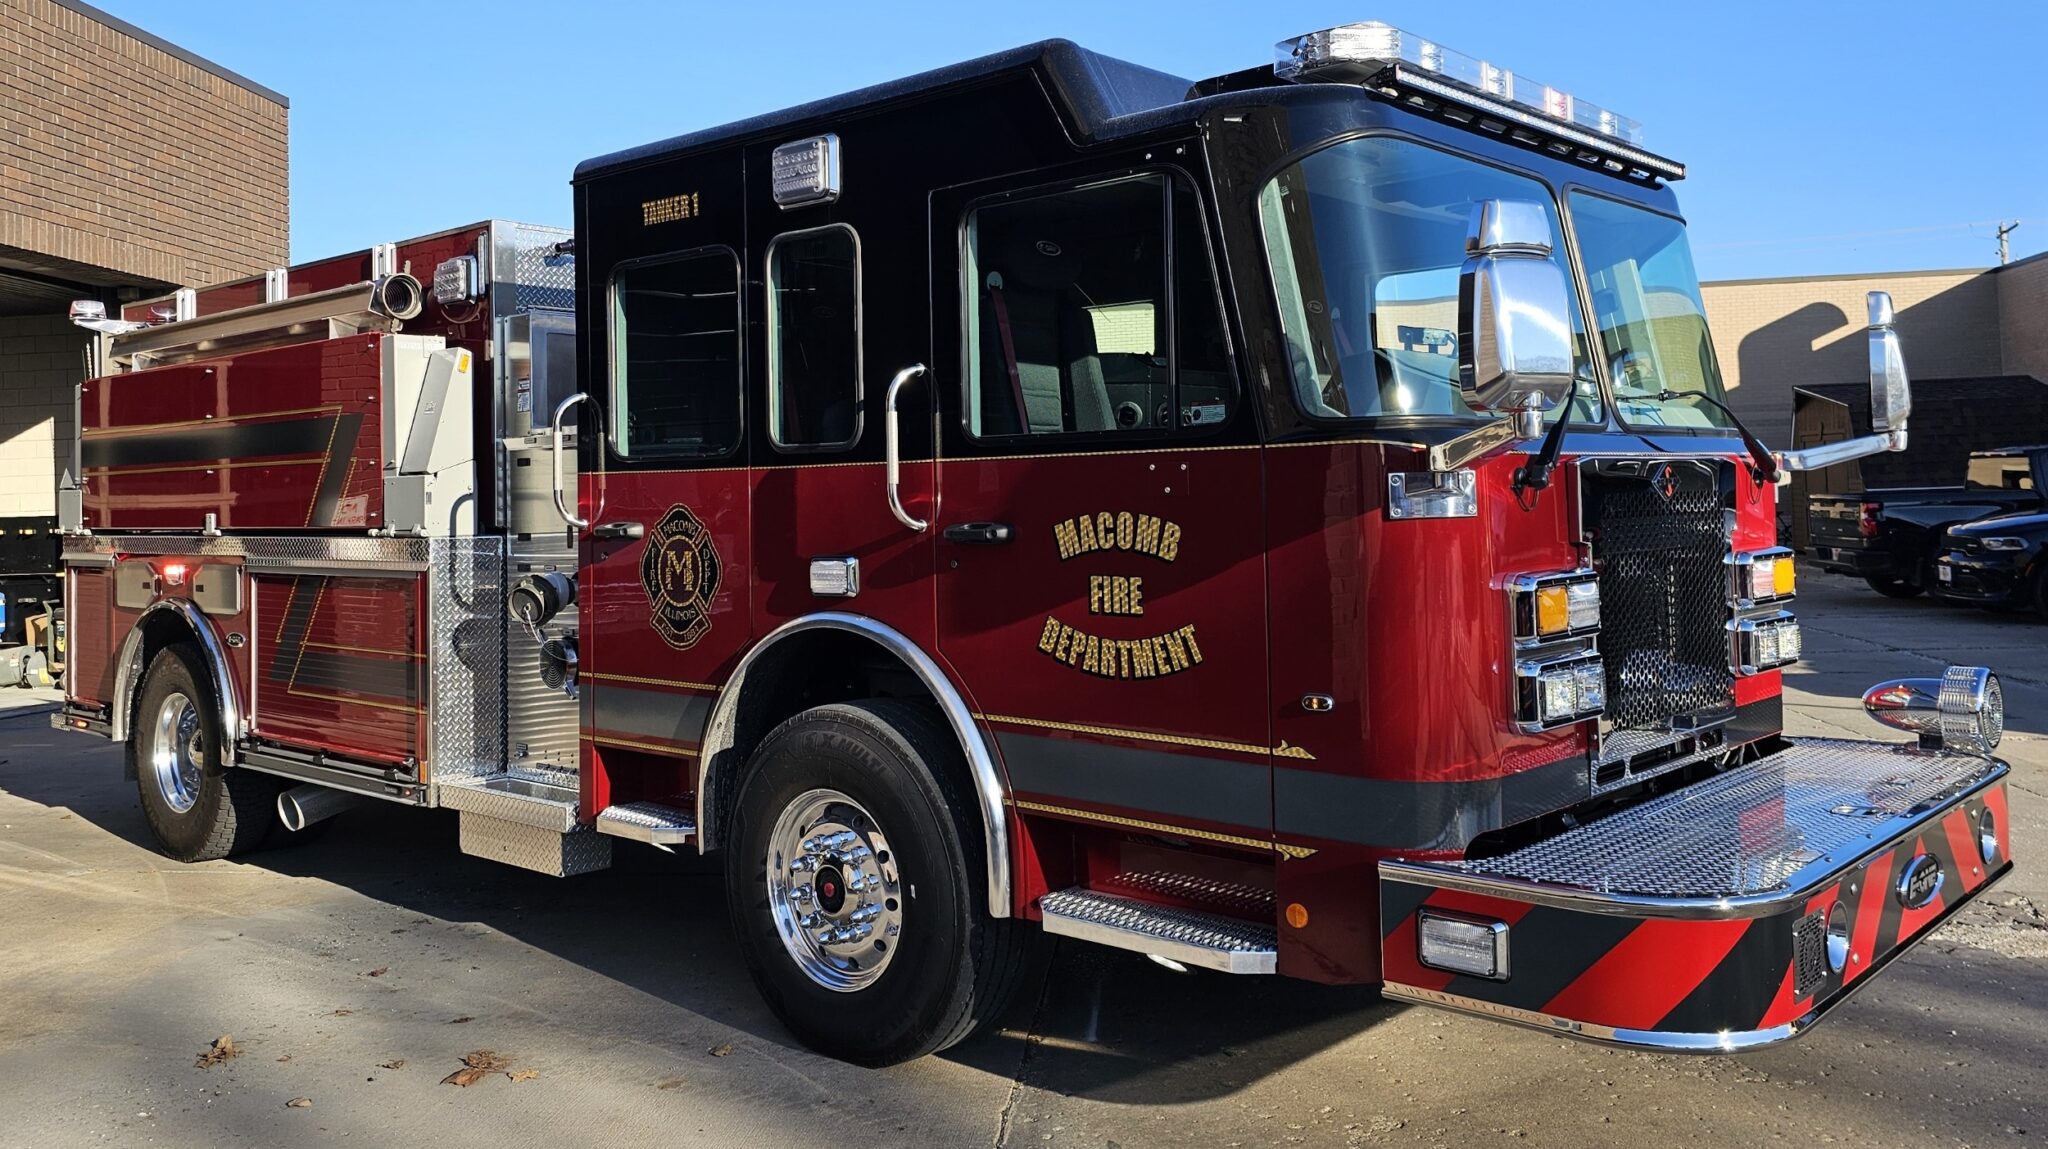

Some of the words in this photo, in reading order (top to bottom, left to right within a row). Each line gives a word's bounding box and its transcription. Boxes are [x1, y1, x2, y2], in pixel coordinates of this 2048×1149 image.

[642, 194, 690, 226] TANKER
[691, 191, 699, 216] 1
[663, 519, 696, 537] MACOMB
[1054, 511, 1181, 562] MACOMB
[703, 549, 711, 594] DEPT
[664, 606, 697, 621] ILLINOIS
[1090, 575, 1144, 615] FIRE
[1038, 615, 1203, 678] DEPARTMENT
